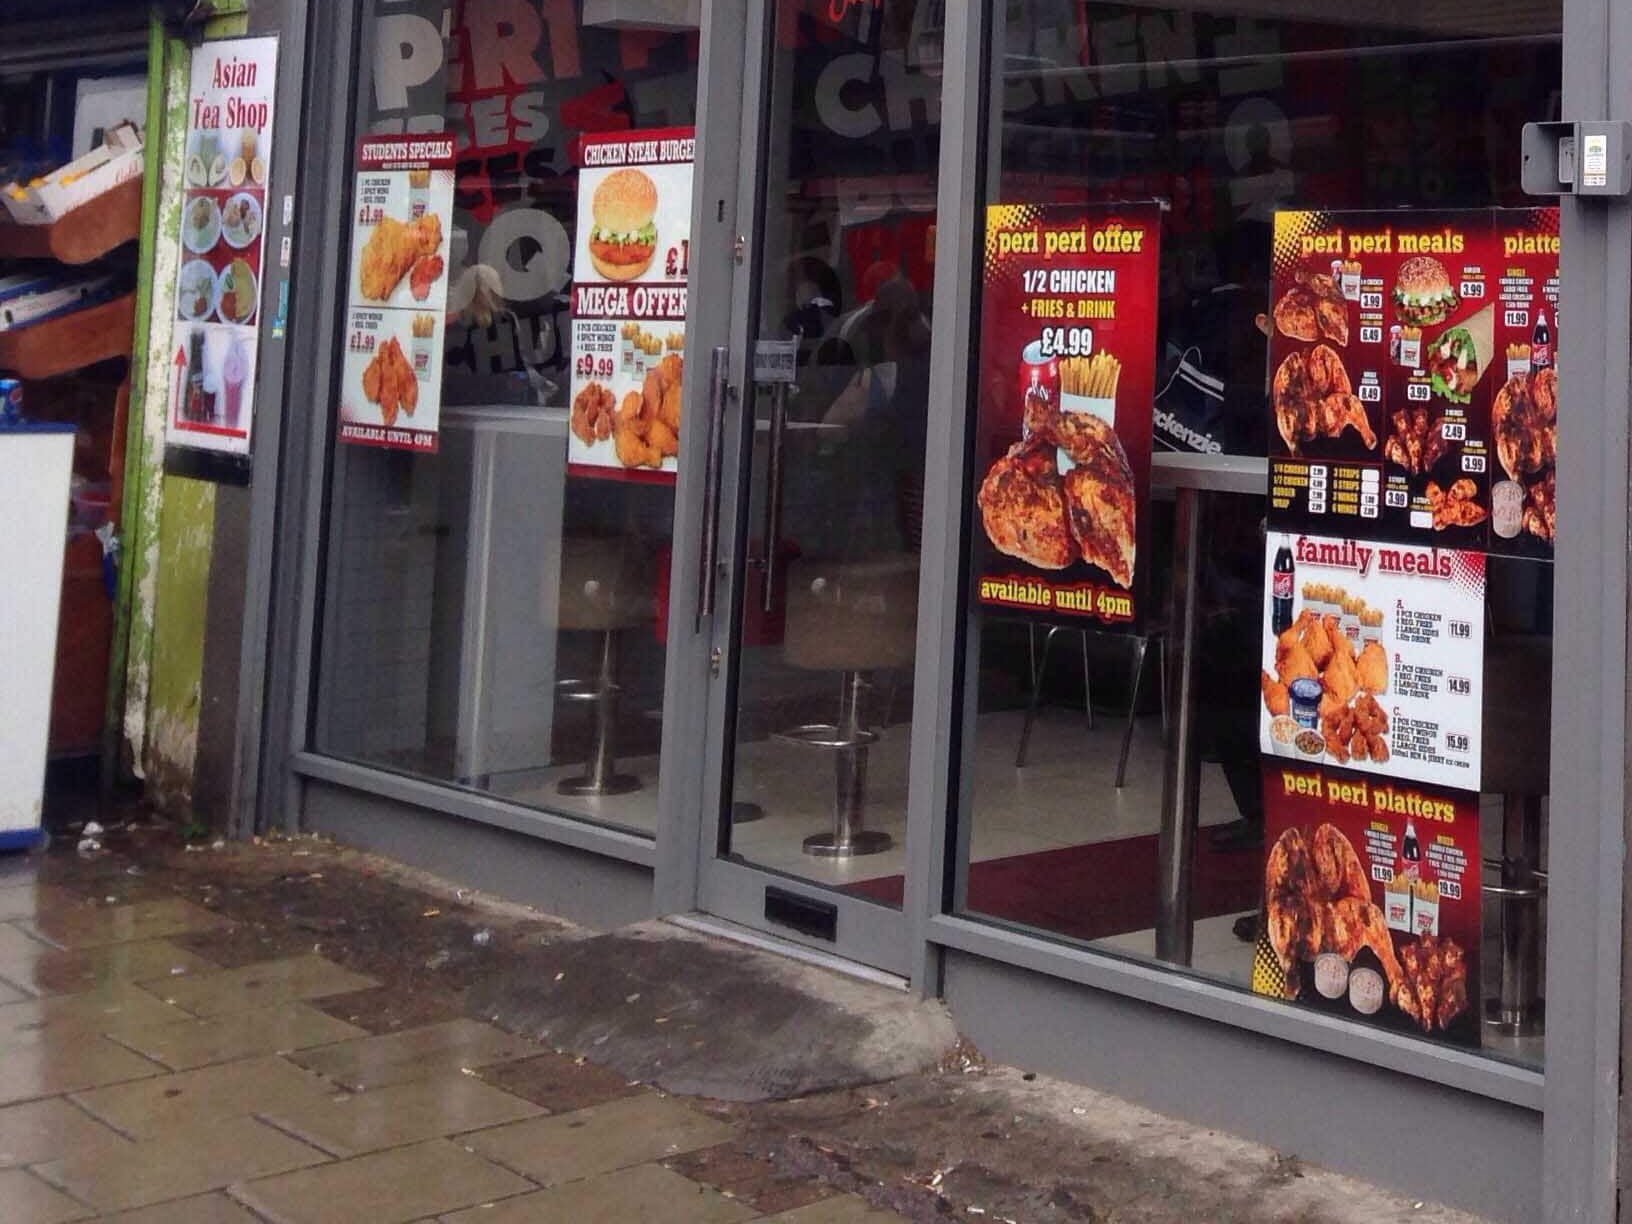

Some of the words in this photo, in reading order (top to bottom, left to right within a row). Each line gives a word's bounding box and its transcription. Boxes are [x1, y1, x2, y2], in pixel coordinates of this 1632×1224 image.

[211, 55, 257, 90] Asian
[193, 97, 221, 130] Tea
[226, 94, 269, 137] Shop
[361, 142, 408, 161] STUDENTS
[408, 141, 453, 159] SPECIALS
[584, 142, 627, 166] CHICKEN
[627, 140, 659, 164] STEAK
[998, 225, 1040, 259] peri
[1044, 224, 1087, 259] peri
[1092, 223, 1144, 253] offer
[1300, 228, 1342, 259] peri
[1349, 228, 1392, 259] peri
[1398, 228, 1465, 254] meals
[1503, 230, 1561, 259] platte
[1023, 270, 1047, 294] 1/2
[1050, 270, 1116, 294] CHICKEN
[1463, 284, 1482, 297] 3.99
[577, 287, 630, 316] MEGA
[1031, 299, 1064, 319] FRIES
[1066, 303, 1075, 319] &
[1077, 300, 1116, 320] DRINK
[1362, 294, 1381, 308] 3.99
[1507, 312, 1528, 326] 11.99
[1041, 327, 1093, 357] £4.99
[576, 353, 614, 378] £9.99
[1409, 386, 1428, 399] 3.99
[342, 425, 386, 441] AVAILABLE
[386, 429, 413, 445] UNTIL
[1445, 425, 1463, 438] 2.49
[1464, 457, 1484, 470] 3.99
[1387, 491, 1406, 505] 3.99
[1296, 535, 1374, 576] family
[1378, 546, 1452, 578] meals
[981, 578, 1052, 606] available
[1055, 587, 1093, 612] until
[1096, 594, 1132, 619] 4pm
[1450, 623, 1471, 638] 11.99
[1448, 679, 1470, 694] 14.99
[1447, 735, 1469, 751] 15.99
[1282, 769, 1323, 797] peri
[1327, 778, 1369, 807] peri
[1373, 789, 1456, 824] platters
[1373, 866, 1393, 882] 11.99
[1439, 880, 1461, 899] 19.99
